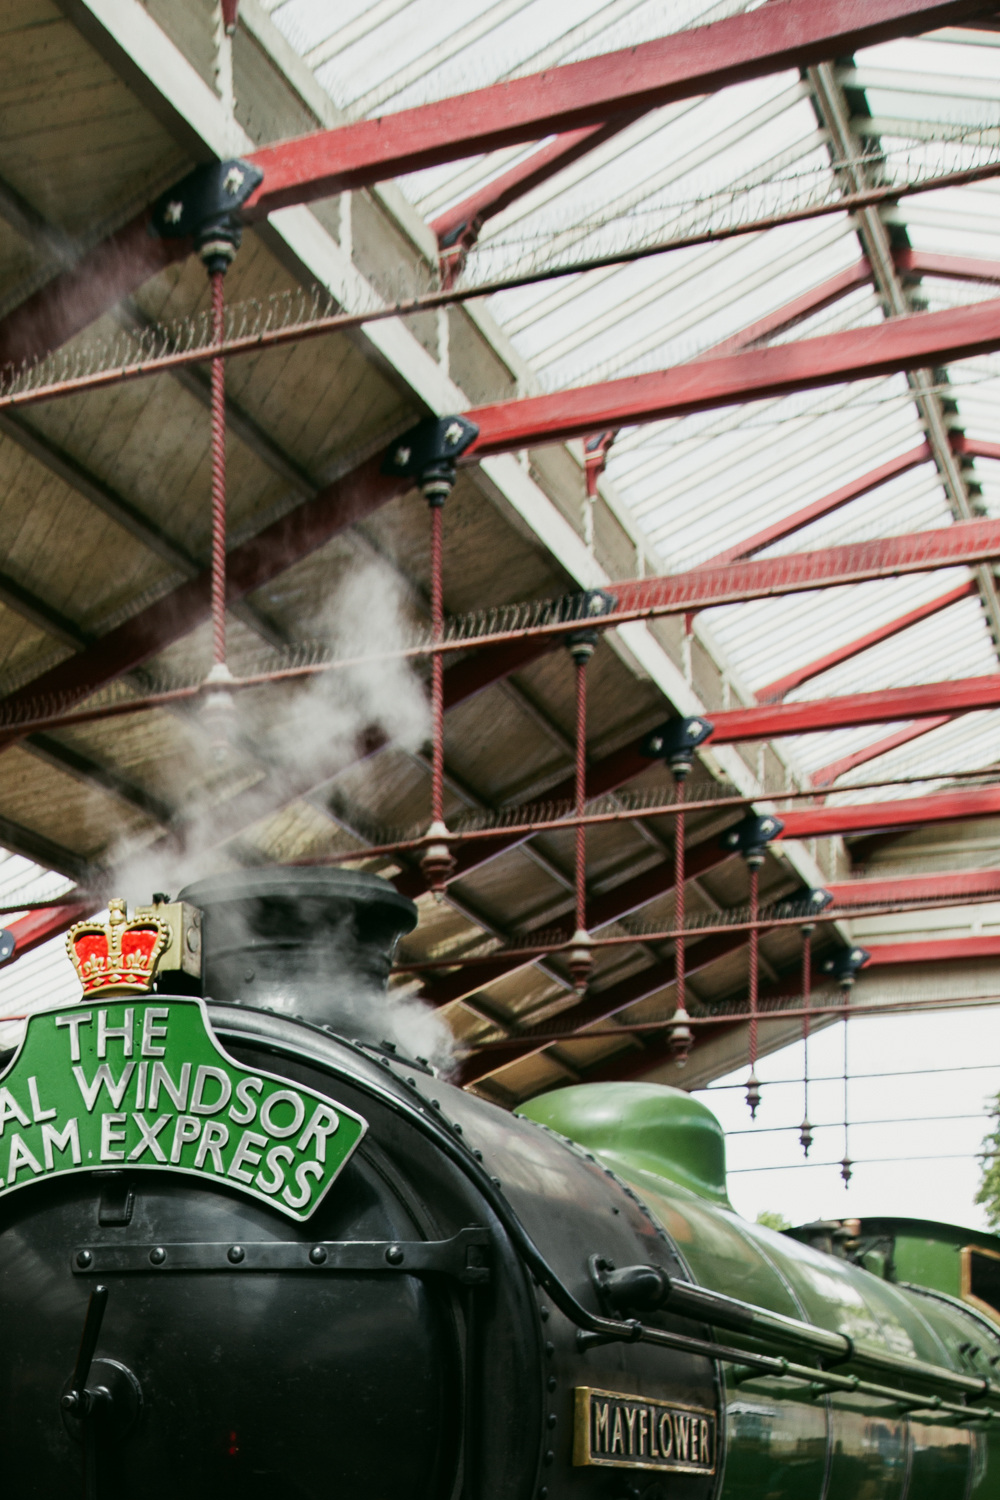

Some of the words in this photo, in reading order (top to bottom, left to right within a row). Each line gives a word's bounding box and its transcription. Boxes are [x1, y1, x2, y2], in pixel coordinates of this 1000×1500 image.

[55, 1007, 170, 1061] THE
[72, 1061, 340, 1163] WINDSOR
[100, 1113, 325, 1208] EXPRESS
[595, 1401, 710, 1464] MAYFLOWER
